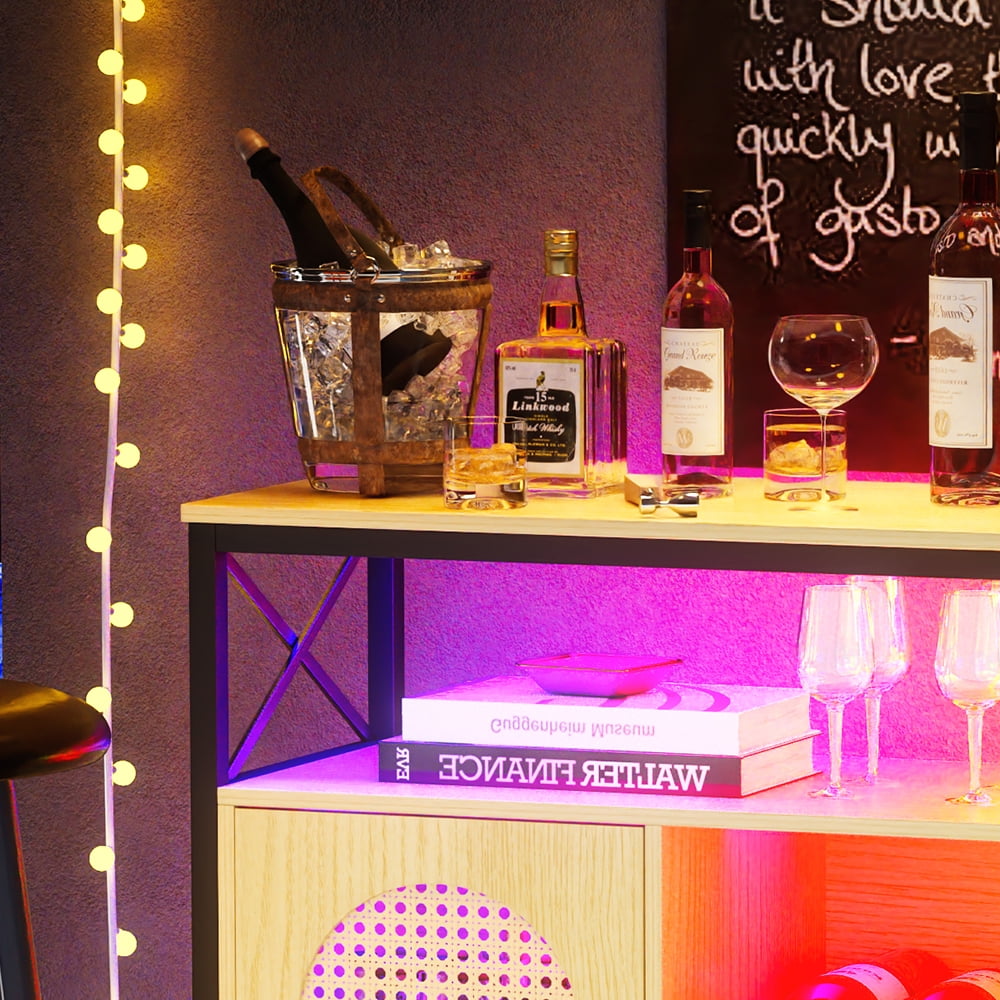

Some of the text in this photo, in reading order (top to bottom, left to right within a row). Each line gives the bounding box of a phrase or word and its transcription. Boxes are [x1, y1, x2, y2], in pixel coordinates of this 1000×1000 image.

[743, 38, 850, 112] with
[860, 42, 954, 103] love
[736, 109, 896, 213] quickly
[730, 177, 786, 268] of
[511, 400, 571, 413] Linkwood
[535, 391, 548, 403] 15
